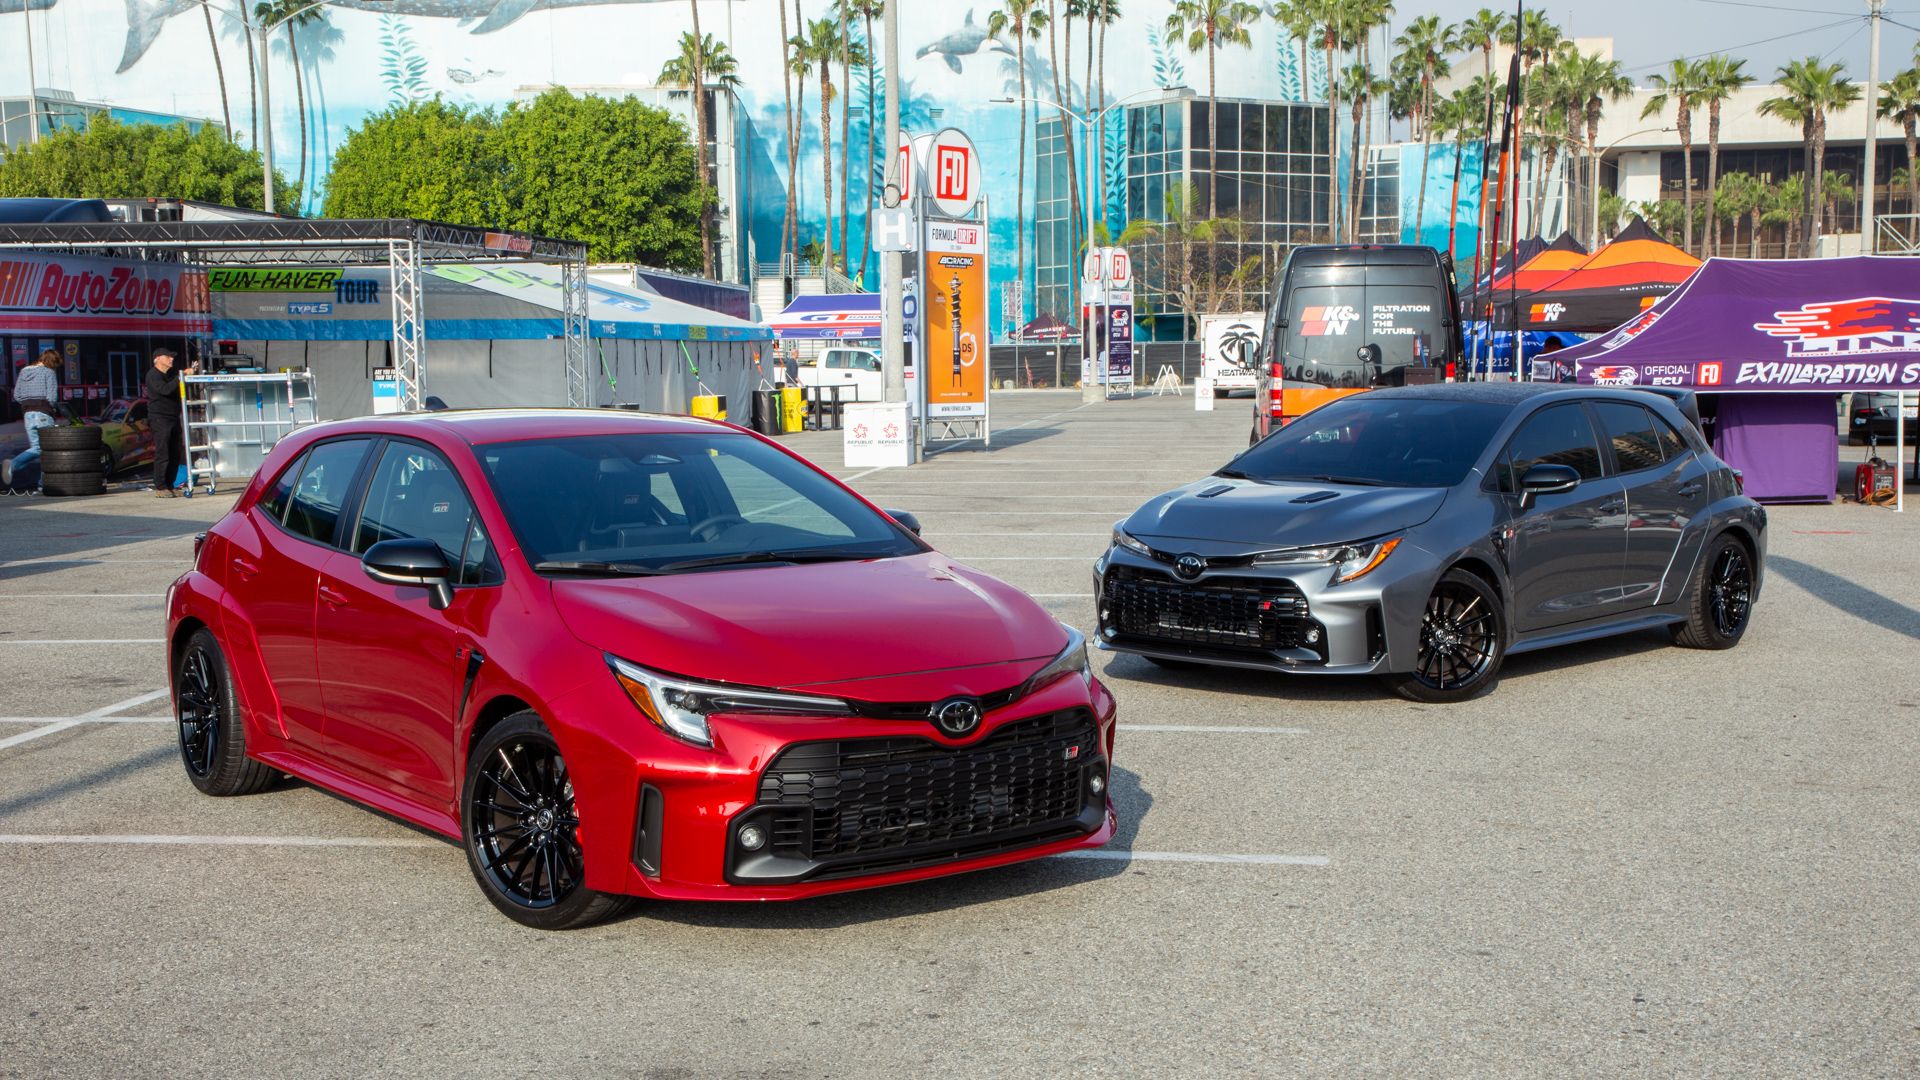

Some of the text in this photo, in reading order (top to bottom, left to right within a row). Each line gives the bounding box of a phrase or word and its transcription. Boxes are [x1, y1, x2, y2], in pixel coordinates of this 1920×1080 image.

[939, 149, 966, 198] FD
[879, 212, 907, 247] H
[931, 228, 977, 244] FORMULA DRIFT
[1114, 255, 1125, 279] FD
[36, 263, 172, 314] AutoZone
[210, 271, 337, 289] FUN-HAVER
[334, 280, 379, 303] TOUR
[1644, 365, 1690, 375] OFFICIAL
[1652, 377, 1683, 385] ECU
[1701, 363, 1720, 384] FD
[1736, 362, 1898, 384] EXHILARATION
